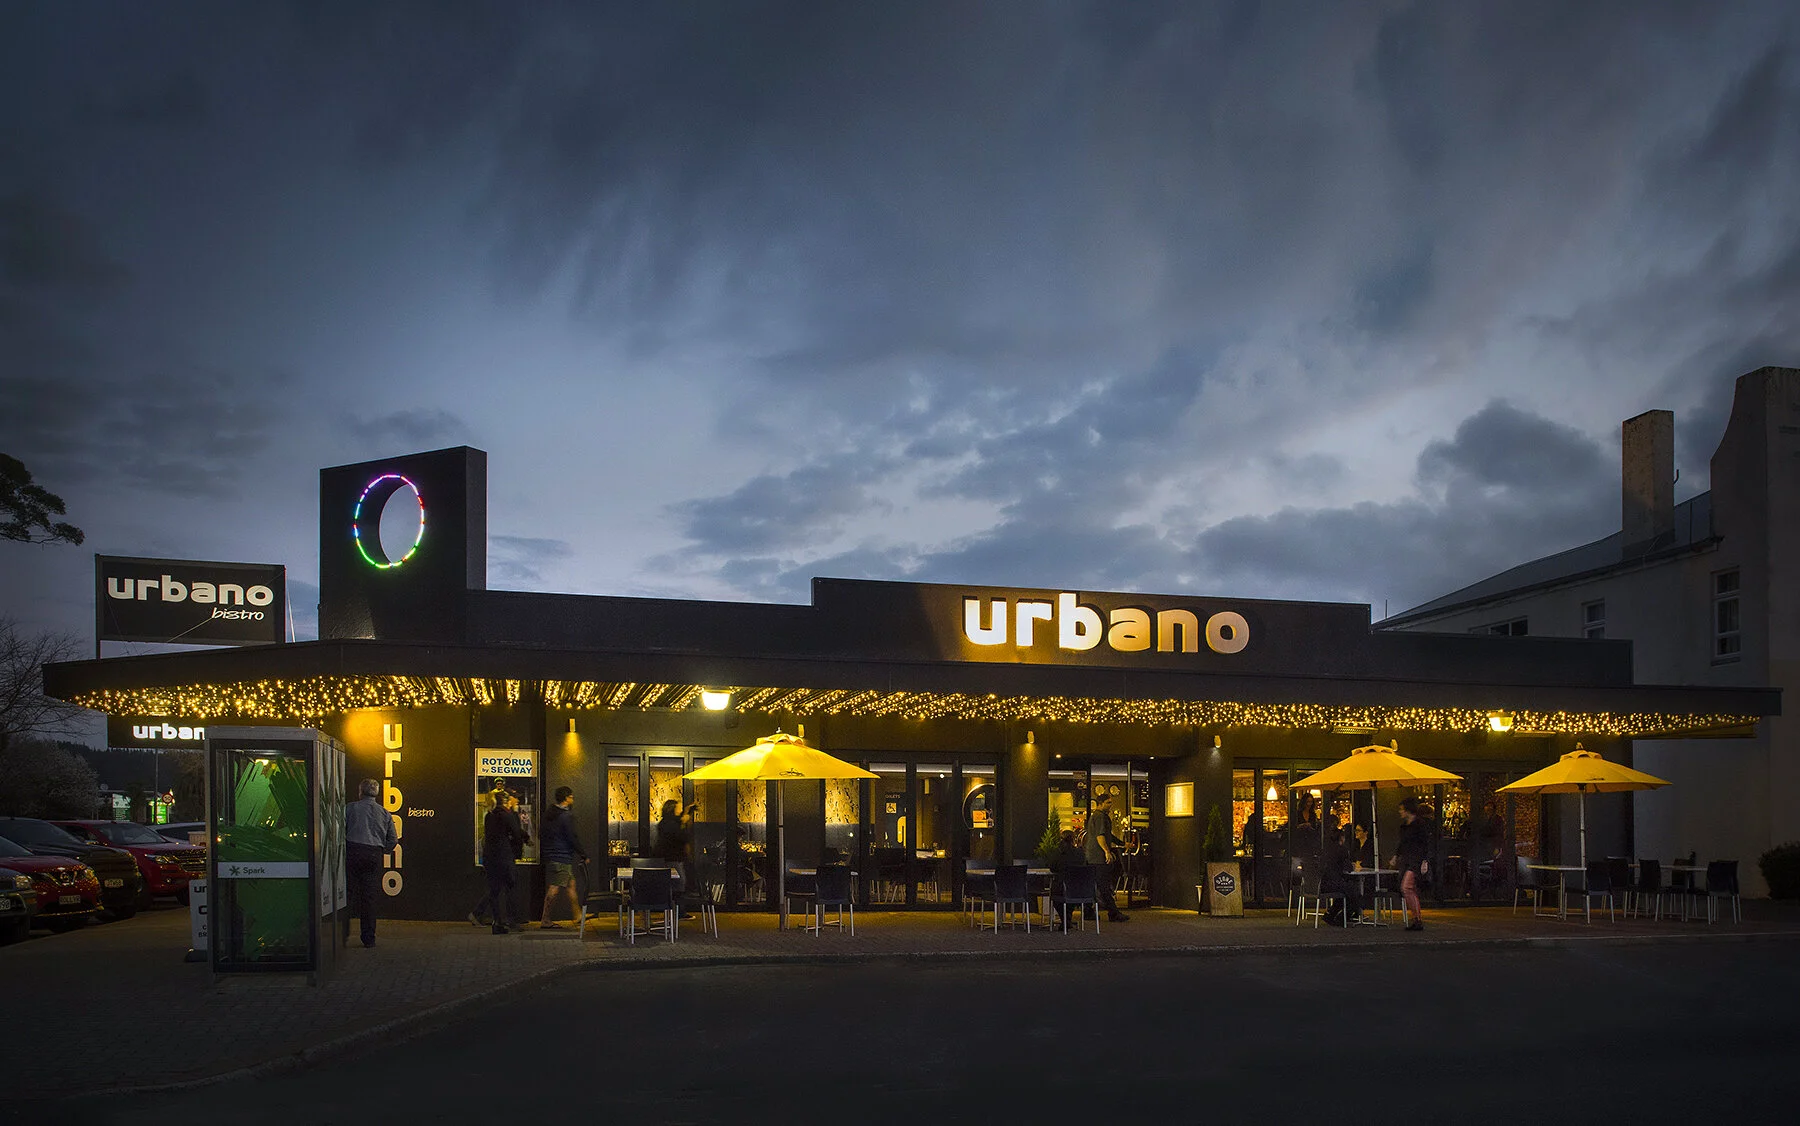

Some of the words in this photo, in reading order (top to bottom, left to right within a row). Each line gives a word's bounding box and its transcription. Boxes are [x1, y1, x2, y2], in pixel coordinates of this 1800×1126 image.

[108, 575, 274, 607] urbano
[211, 607, 264, 621] bistro
[964, 592, 1250, 654] urbano
[133, 723, 205, 740] urban
[482, 758, 532, 766] ROTORUA
[491, 766, 532, 774] SEGWAY
[408, 807, 434, 817] bistro
[243, 867, 265, 875] Spark
